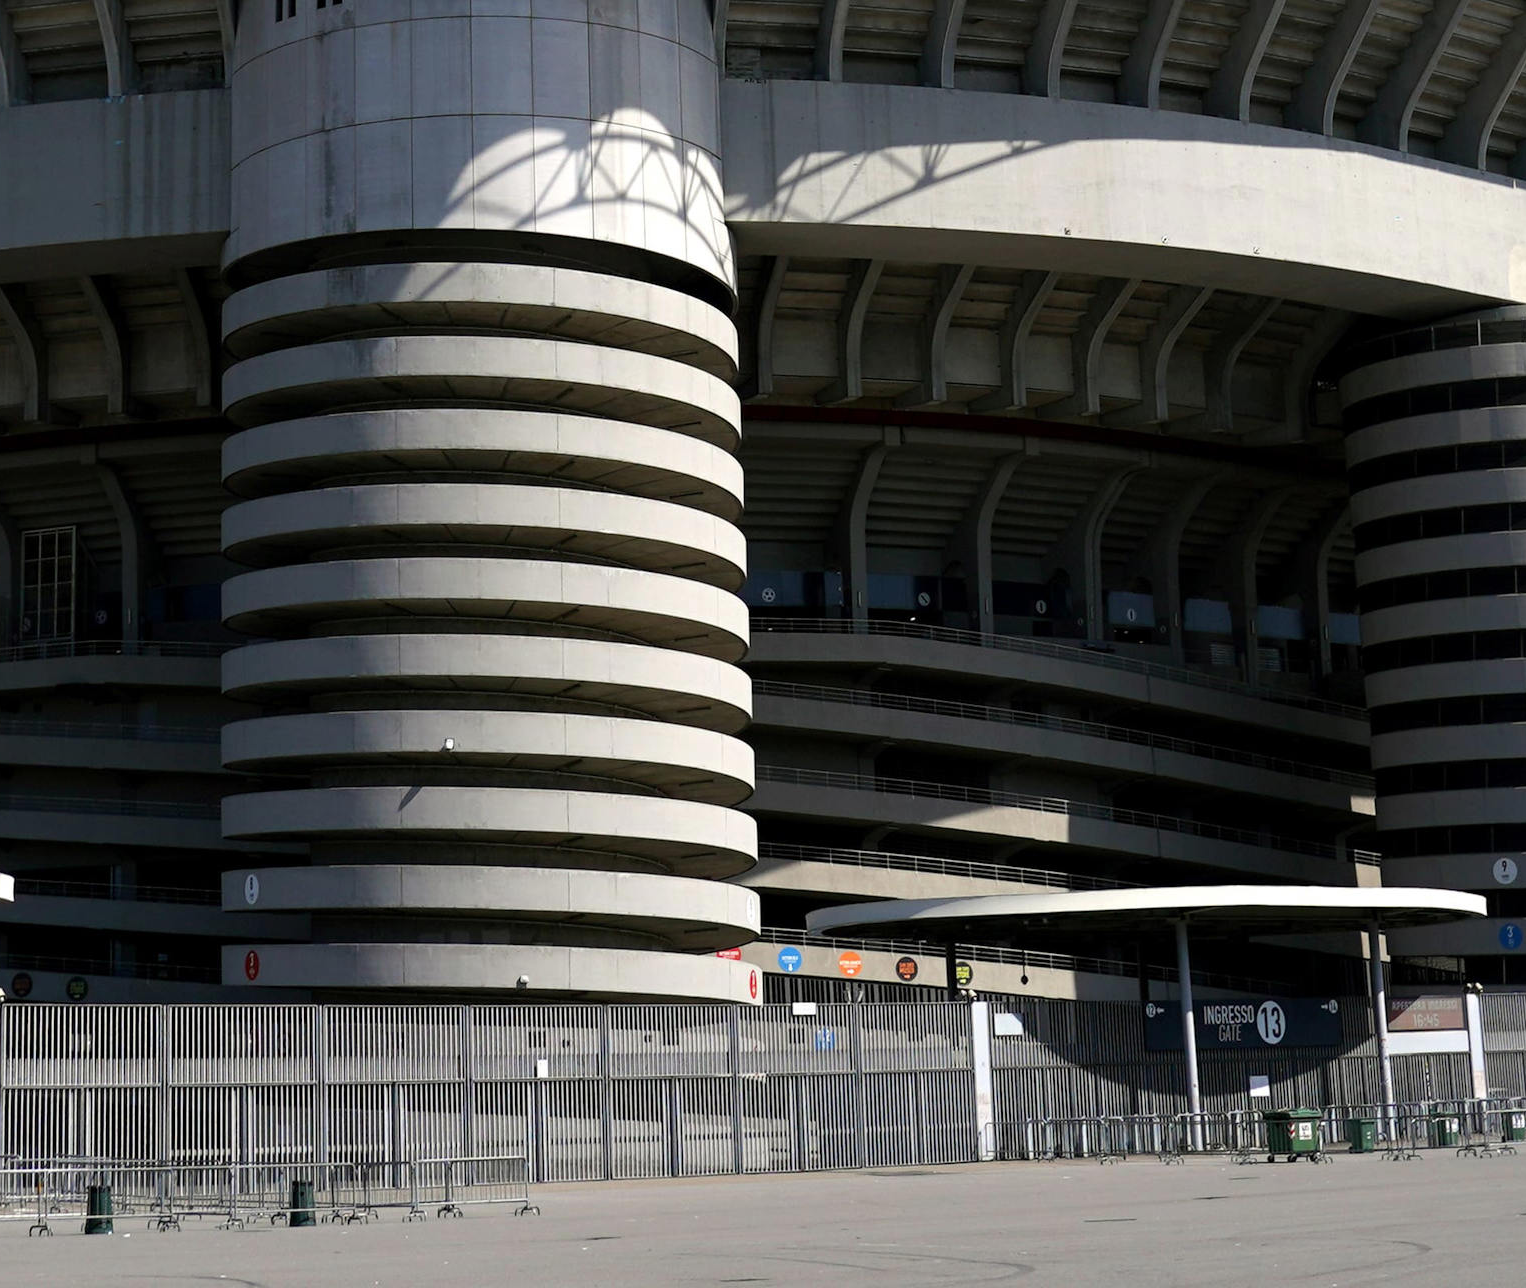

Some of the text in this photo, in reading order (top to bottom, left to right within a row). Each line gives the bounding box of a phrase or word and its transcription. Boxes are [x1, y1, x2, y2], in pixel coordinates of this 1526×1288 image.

[1203, 1005, 1281, 1039] INGRESSO 13
[1413, 1013, 1440, 1027] 16:45
[1218, 1024, 1242, 1042] GATE
